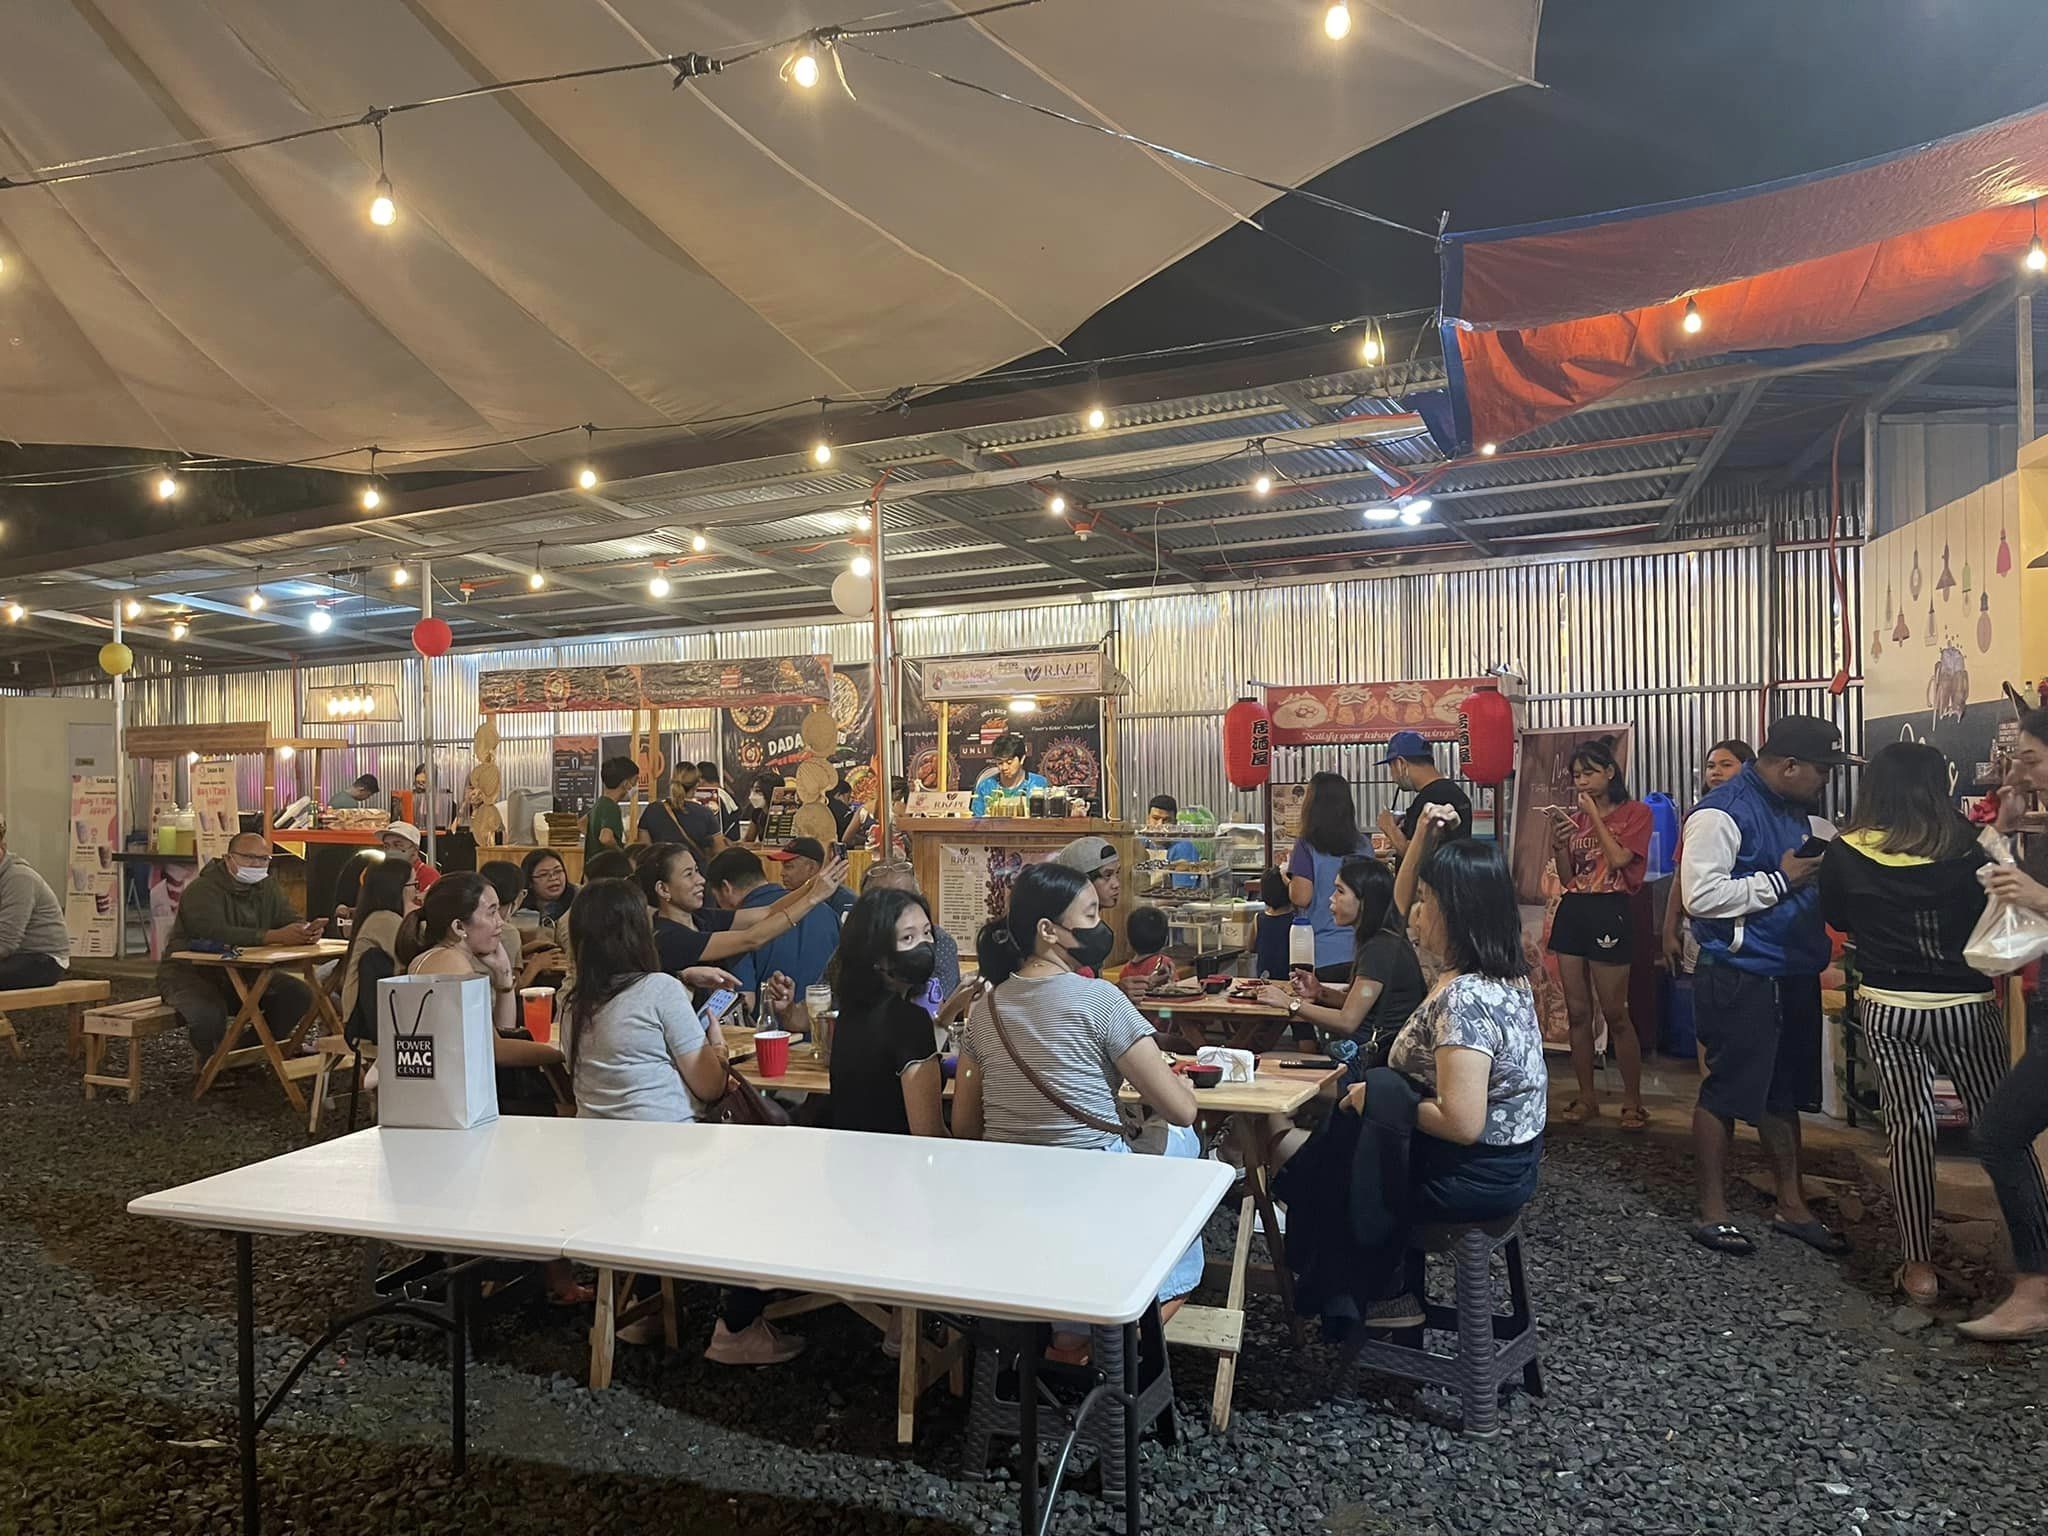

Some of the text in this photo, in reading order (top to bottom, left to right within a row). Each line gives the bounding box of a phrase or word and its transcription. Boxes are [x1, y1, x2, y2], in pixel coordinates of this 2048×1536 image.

[768, 733, 804, 756] DADA
[396, 1040, 432, 1051] POWER
[397, 1052, 432, 1066] MAC
[397, 1067, 433, 1075] CENTER
